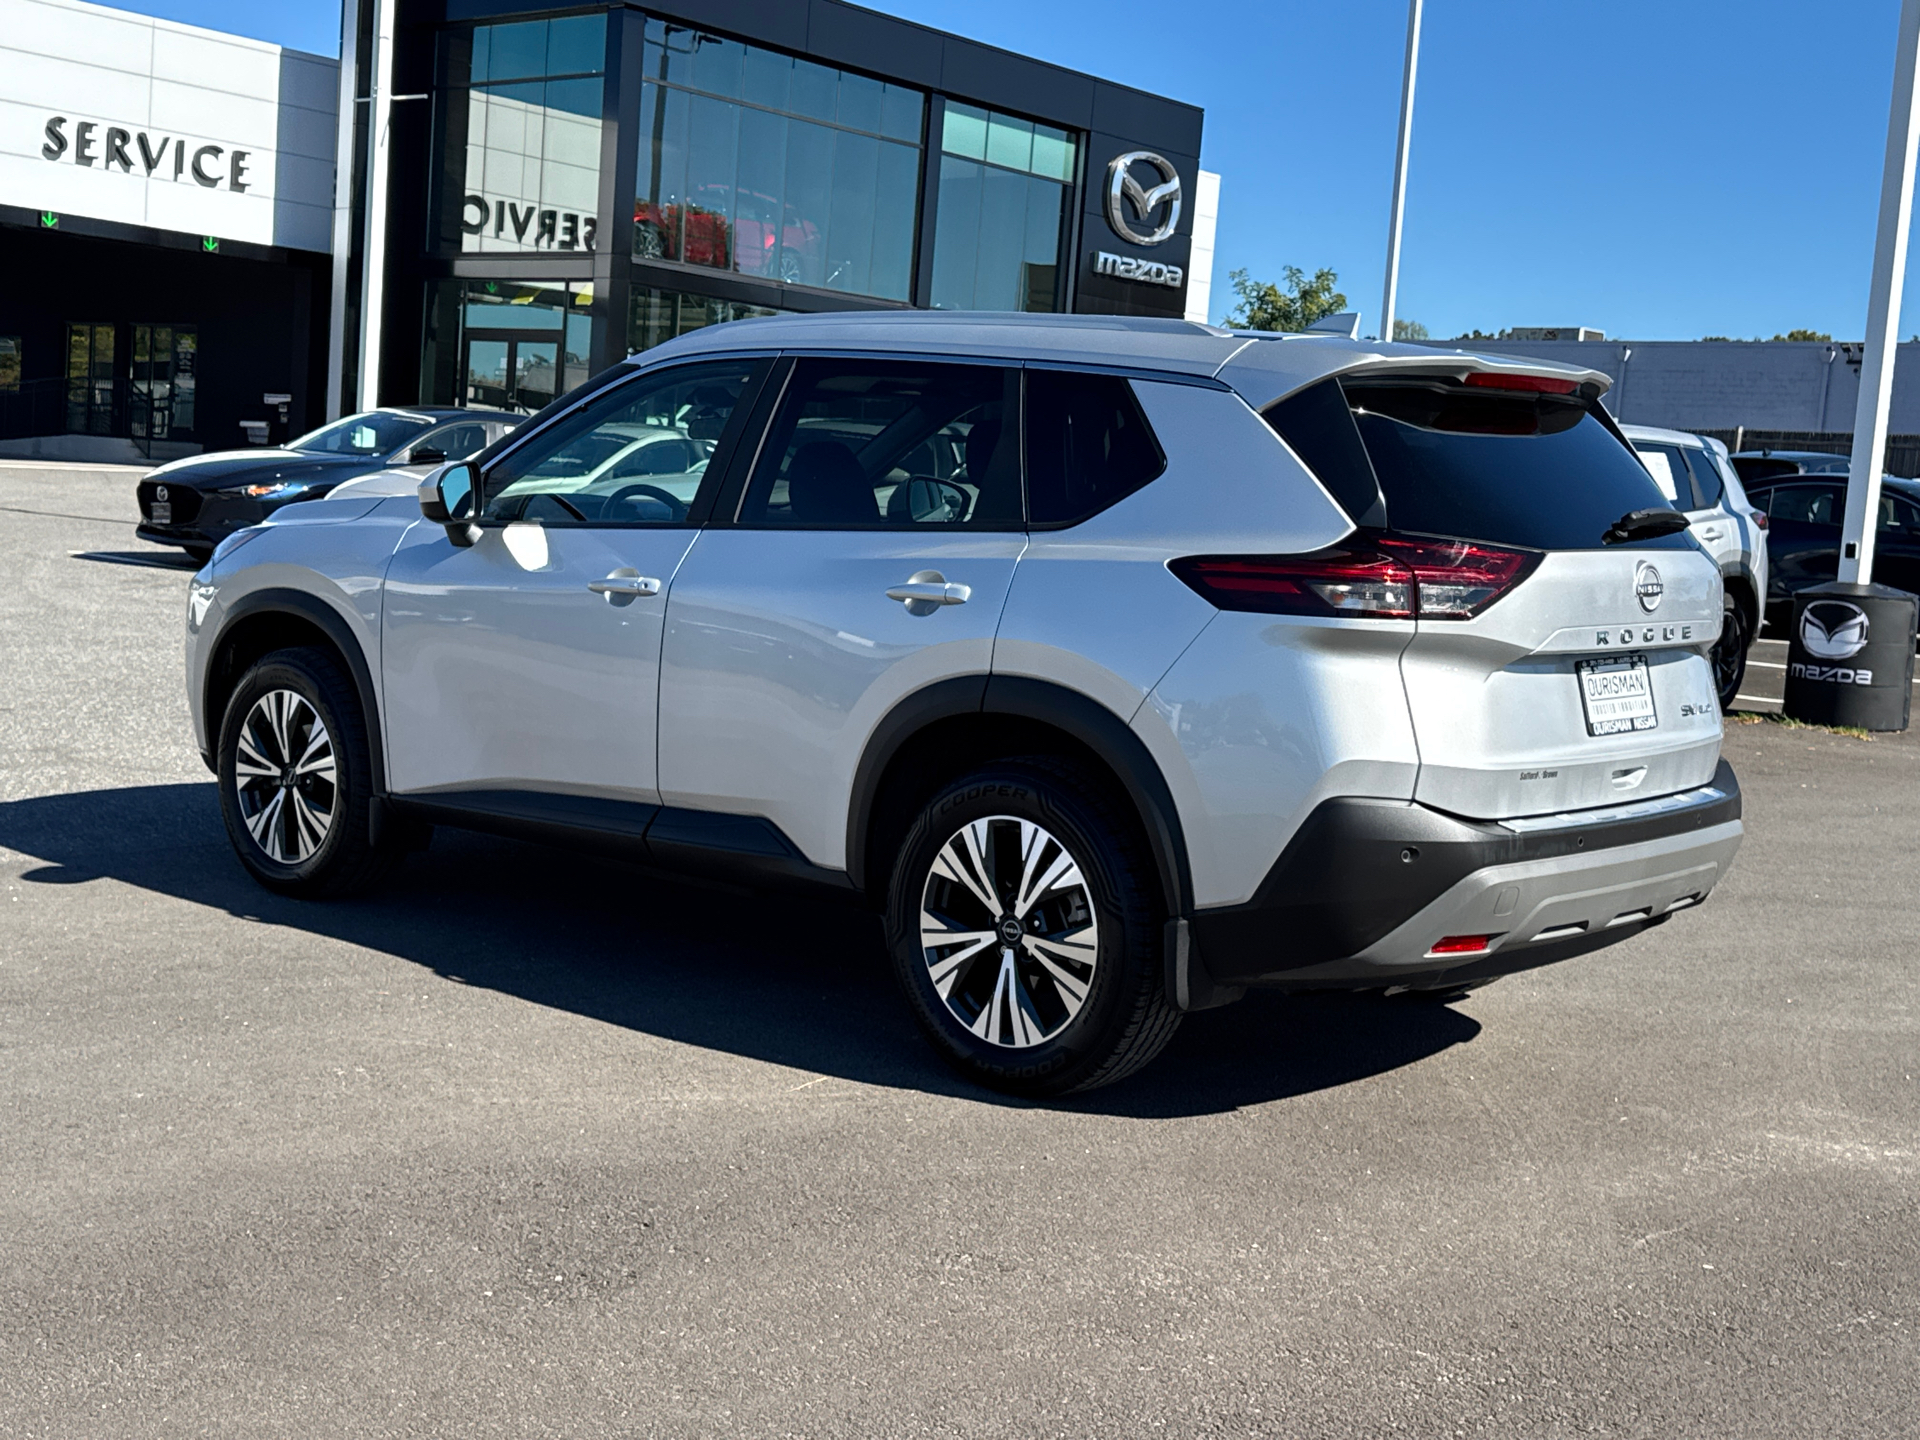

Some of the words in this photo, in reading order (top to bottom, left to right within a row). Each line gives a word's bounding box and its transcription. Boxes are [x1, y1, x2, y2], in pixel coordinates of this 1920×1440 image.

[42, 116, 252, 194] SERVICE
[1094, 251, 1183, 287] mazda
[1596, 625, 1692, 646] ROGUE
[1790, 662, 1873, 685] mazda
[1588, 675, 1644, 696] OURISMAN
[1593, 718, 1632, 735] OURISMAN
[1633, 715, 1656, 730] NISSAN
[939, 785, 1029, 816] COOPER
